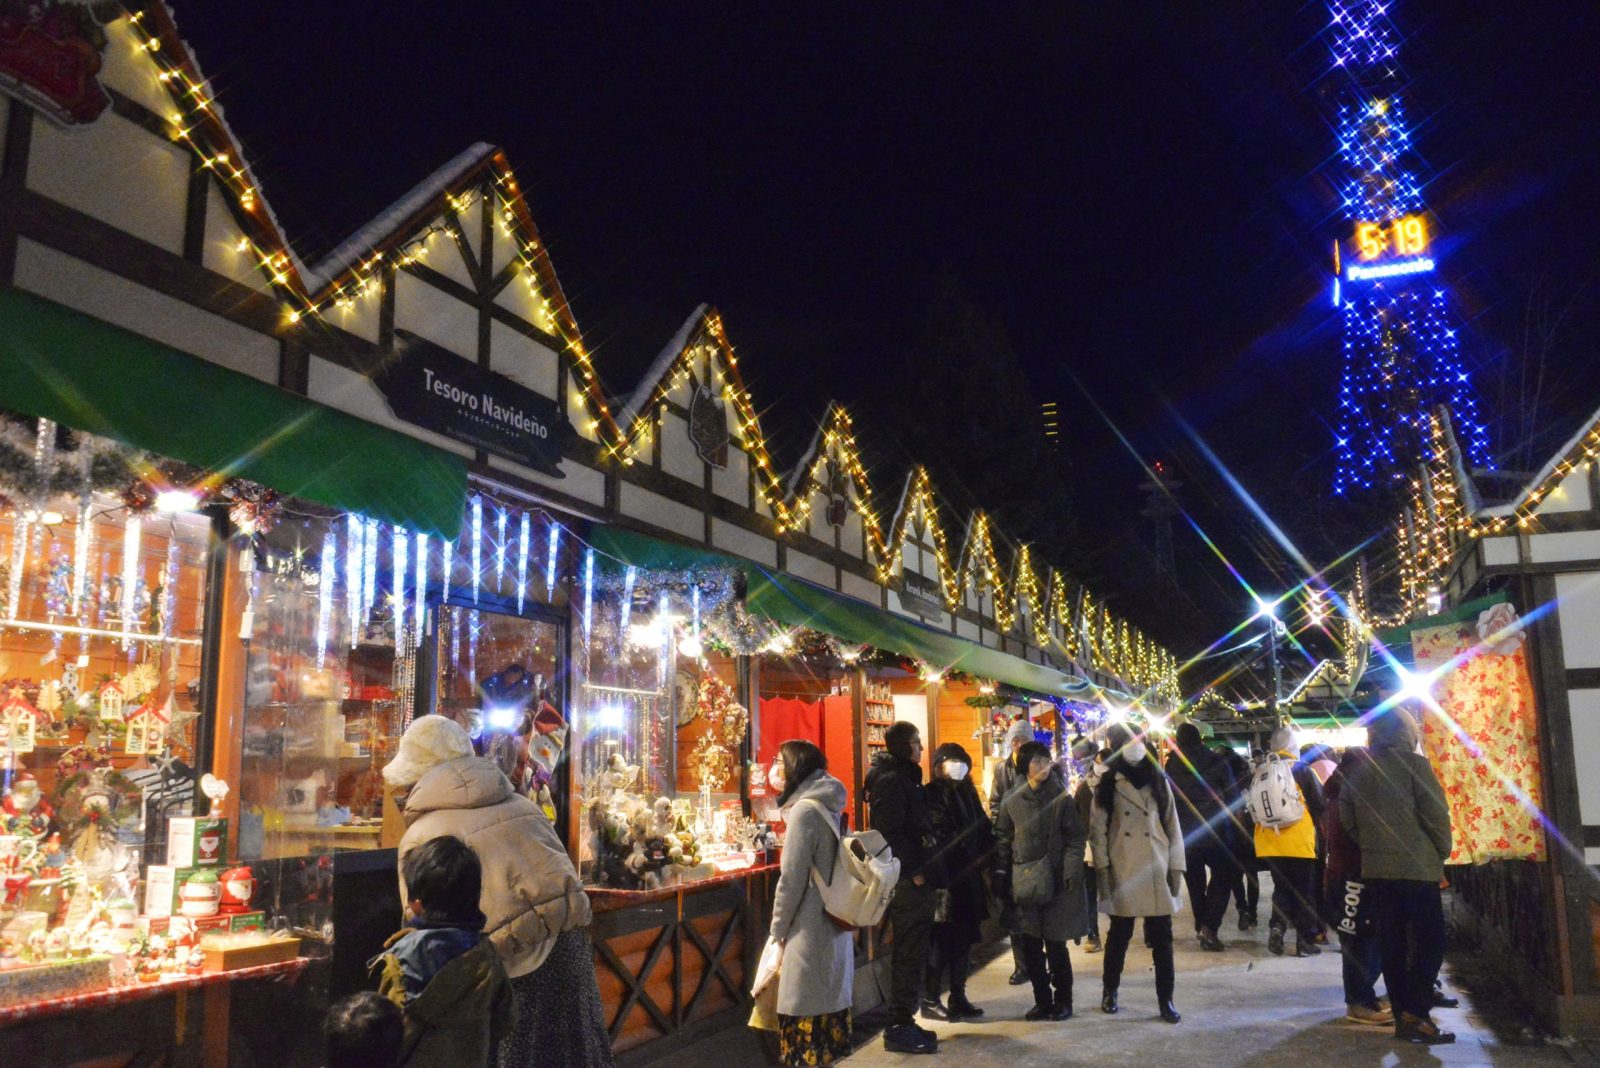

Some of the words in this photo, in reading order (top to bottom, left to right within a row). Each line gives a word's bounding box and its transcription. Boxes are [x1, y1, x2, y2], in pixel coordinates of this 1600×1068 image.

[1358, 217, 1426, 260] 5:19
[424, 368, 478, 410] Tesoro
[482, 395, 549, 440] Navideño
